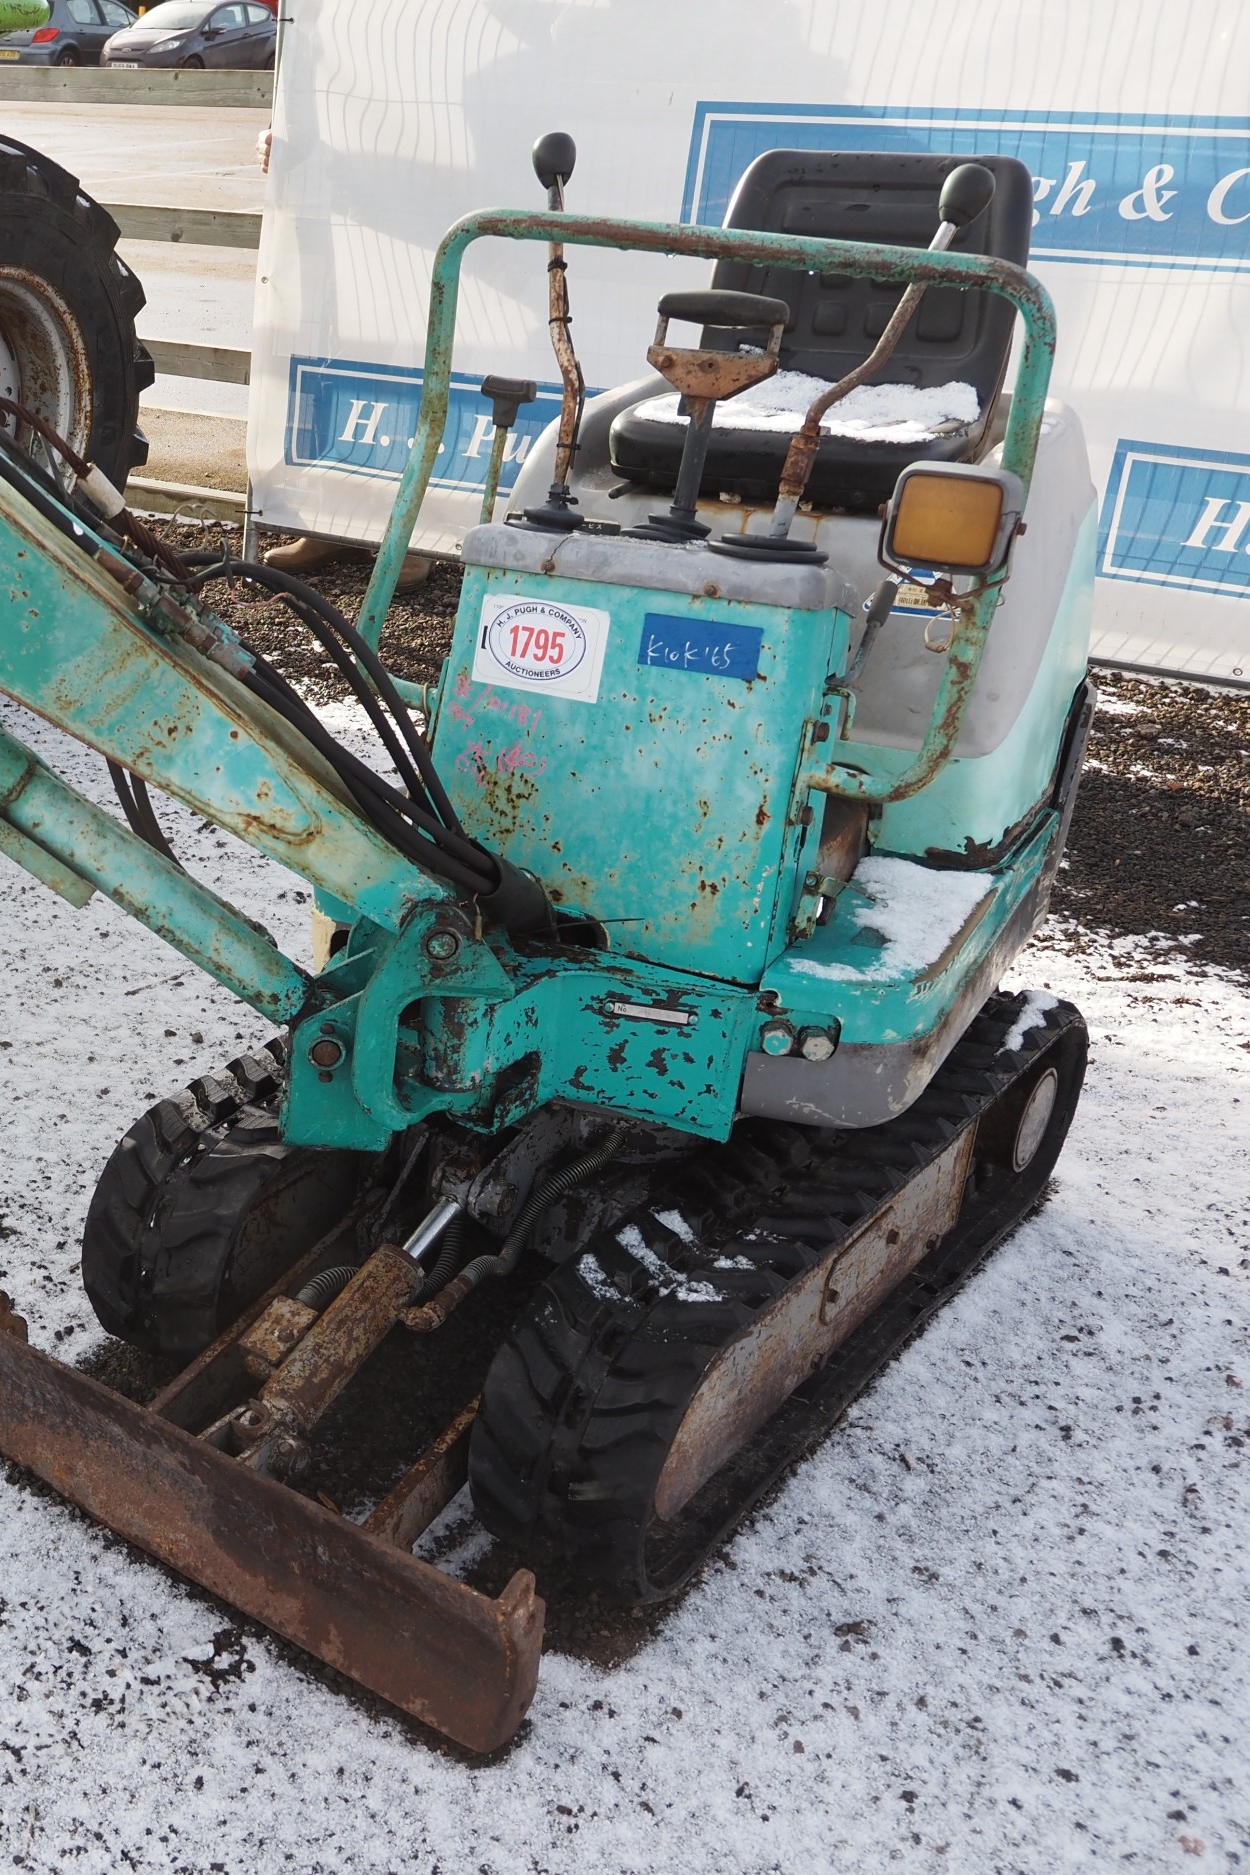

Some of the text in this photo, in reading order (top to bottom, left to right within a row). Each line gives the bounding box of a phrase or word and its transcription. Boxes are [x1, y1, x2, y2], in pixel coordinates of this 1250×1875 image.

[1031, 160, 1250, 228] gh & C
[337, 399, 391, 447] H.
[461, 414, 532, 464] Pu
[581, 522, 603, 530] ービス
[496, 619, 510, 628] H.
[514, 606, 538, 616] PUGH
[539, 606, 546, 614] &
[548, 608, 583, 640] COMPANY
[509, 624, 566, 665] 1795
[505, 660, 561, 678] AUCTIONEERS
